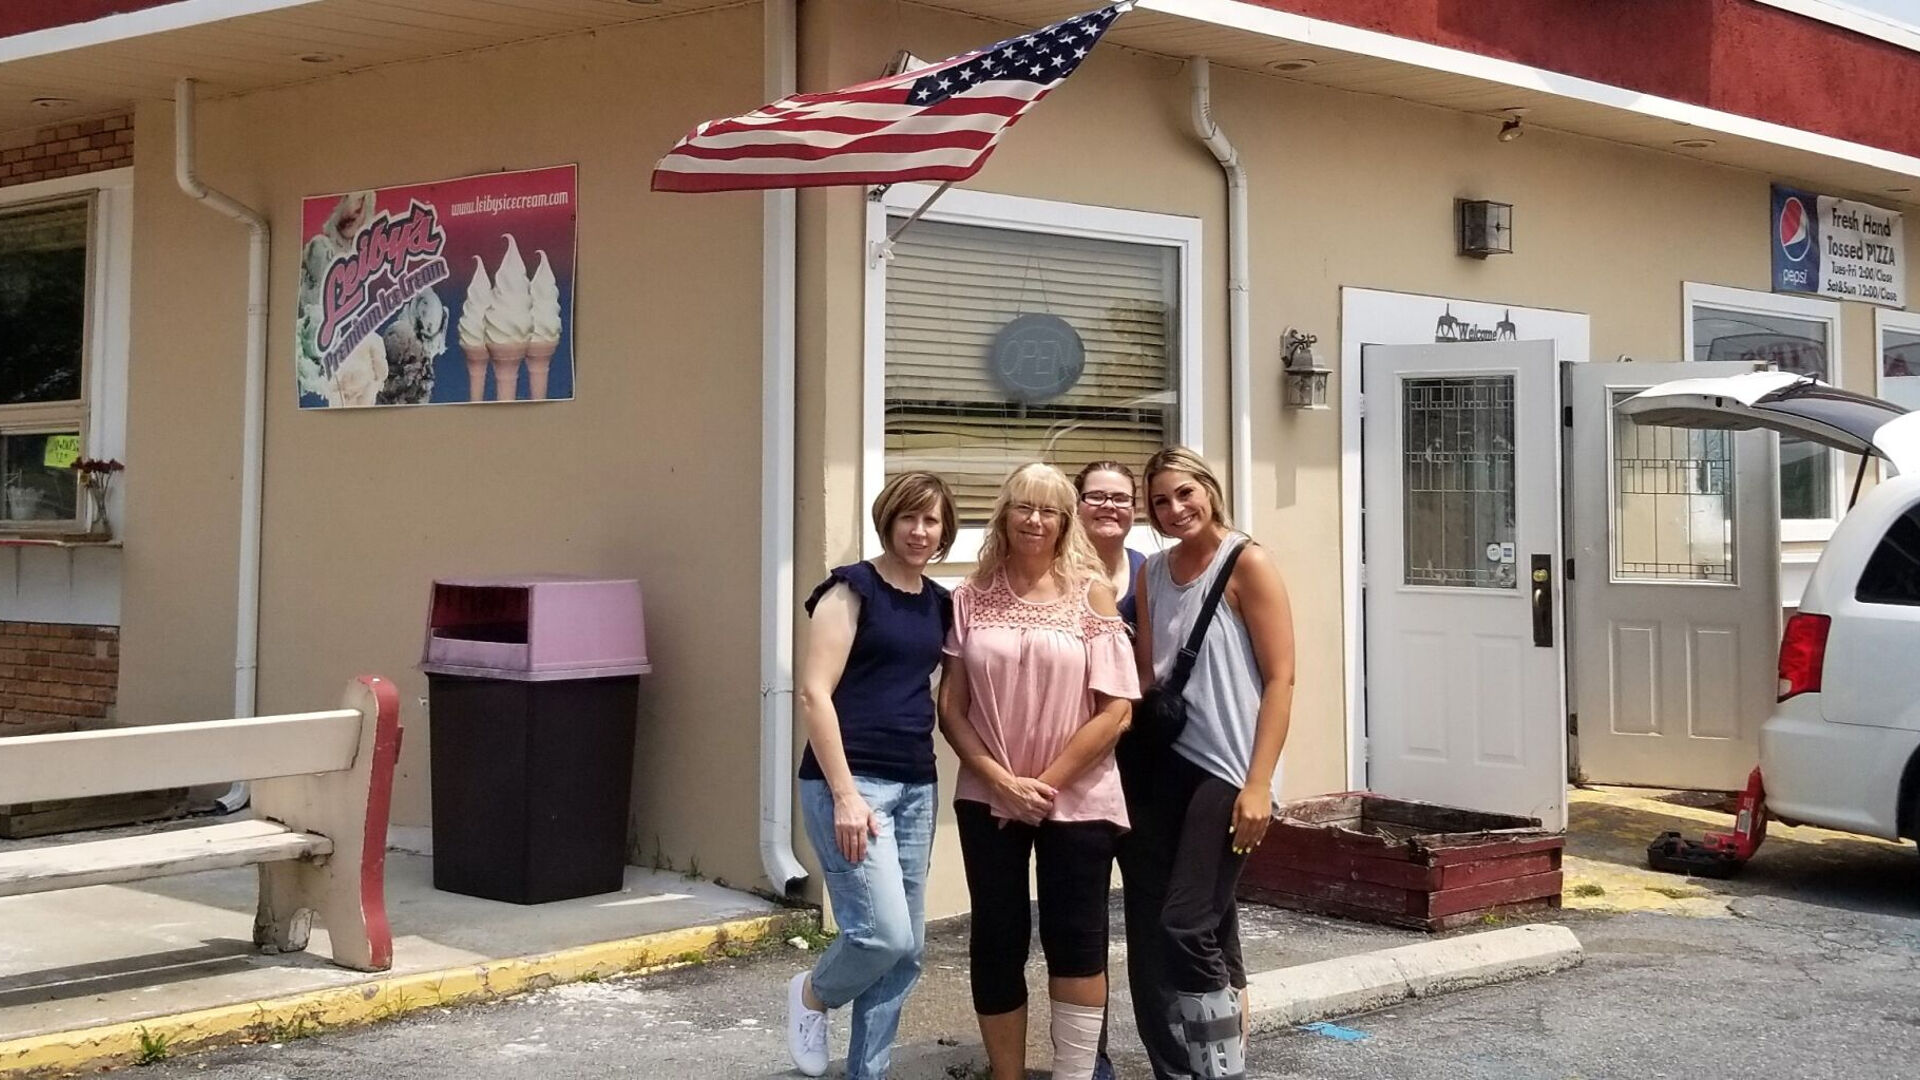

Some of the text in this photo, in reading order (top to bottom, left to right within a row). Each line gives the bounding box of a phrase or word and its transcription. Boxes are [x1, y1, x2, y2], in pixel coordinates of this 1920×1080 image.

[451, 191, 568, 216] www.leibysicecream.com
[1831, 207, 1891, 237] Fresh Hand
[1827, 235, 1896, 267] Tossed PIZZA
[318, 204, 443, 349] Leiby's
[1782, 267, 1809, 286] pepsi
[1831, 261, 1857, 277] Tues-Fri
[323, 260, 447, 381] Premium Ice Cream
[1459, 322, 1498, 341] Welcome
[1000, 339, 1073, 377] OPEN
